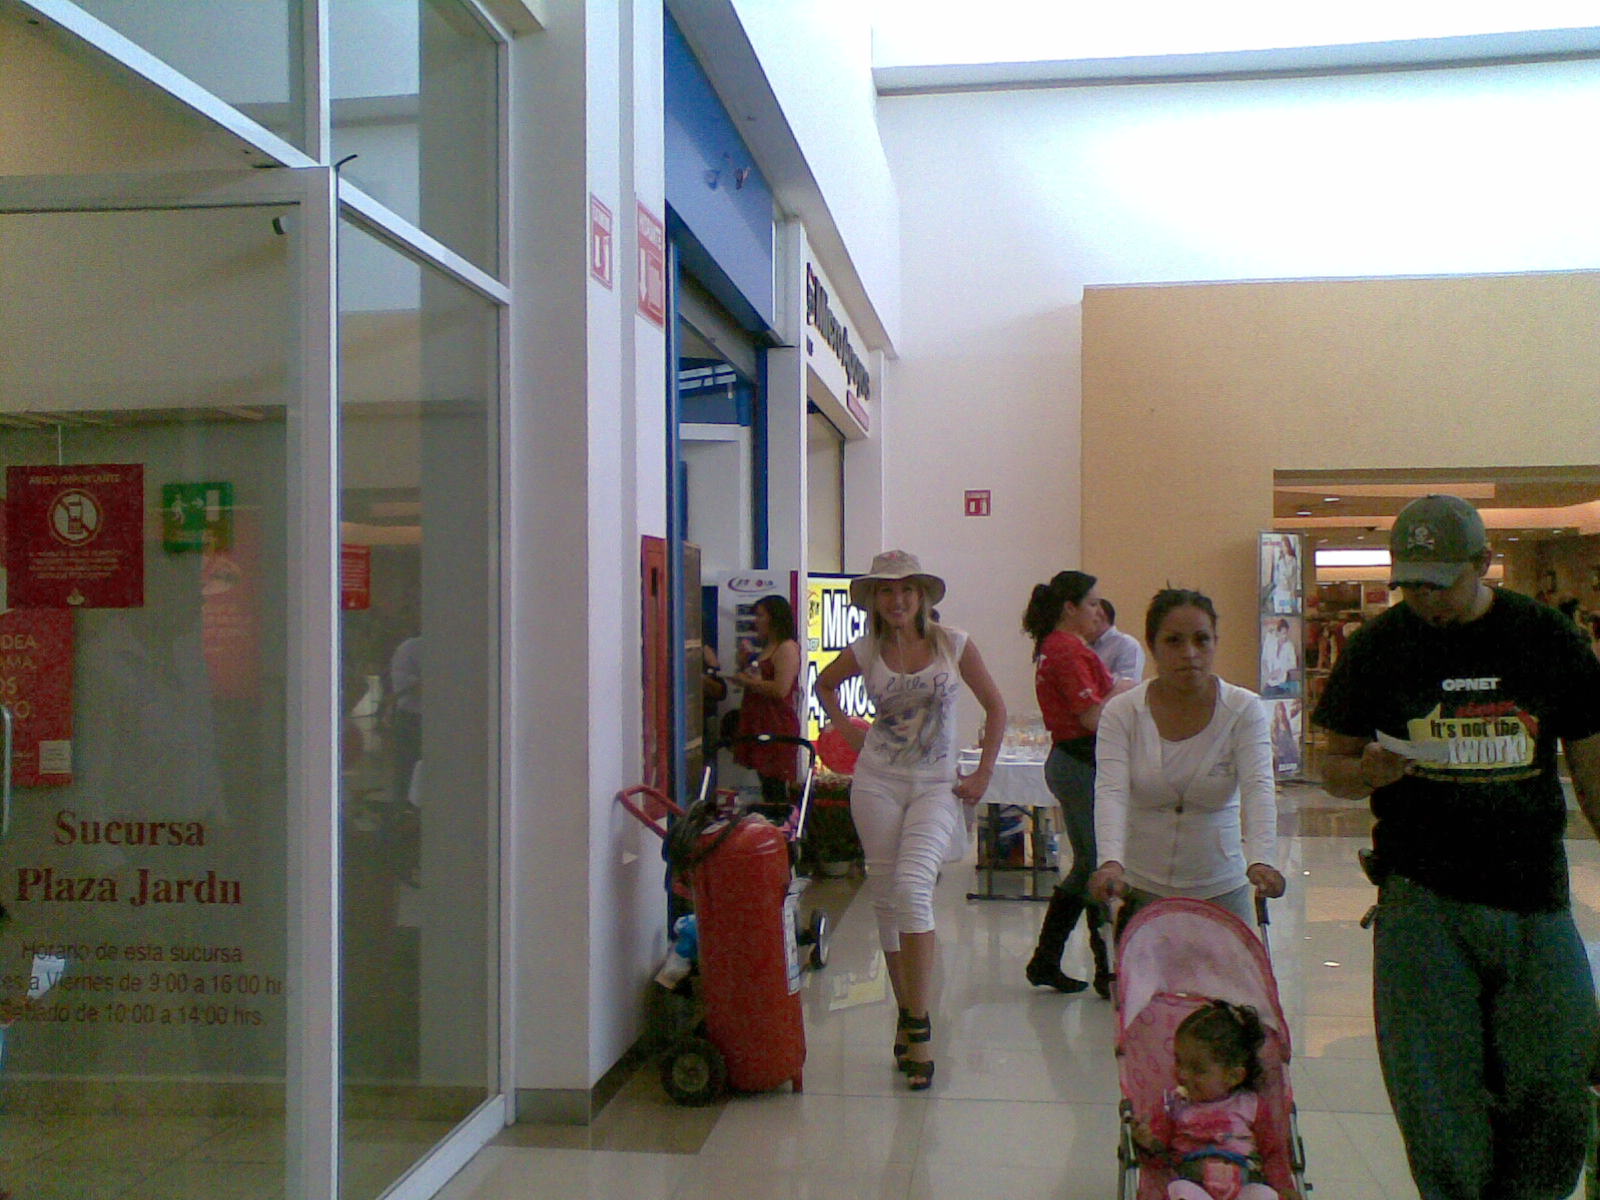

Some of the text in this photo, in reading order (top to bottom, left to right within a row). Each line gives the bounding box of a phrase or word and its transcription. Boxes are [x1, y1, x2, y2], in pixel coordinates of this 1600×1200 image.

[1461, 720, 1489, 738] not
[1494, 718, 1520, 737] the
[16, 868, 119, 902] Plaza
[96, 941, 119, 961] de
[125, 943, 164, 962] esta
[29, 975, 40, 991] a
[119, 972, 143, 993] de
[193, 977, 205, 994] a
[77, 1002, 100, 1022] de
[160, 1008, 172, 1025] a
